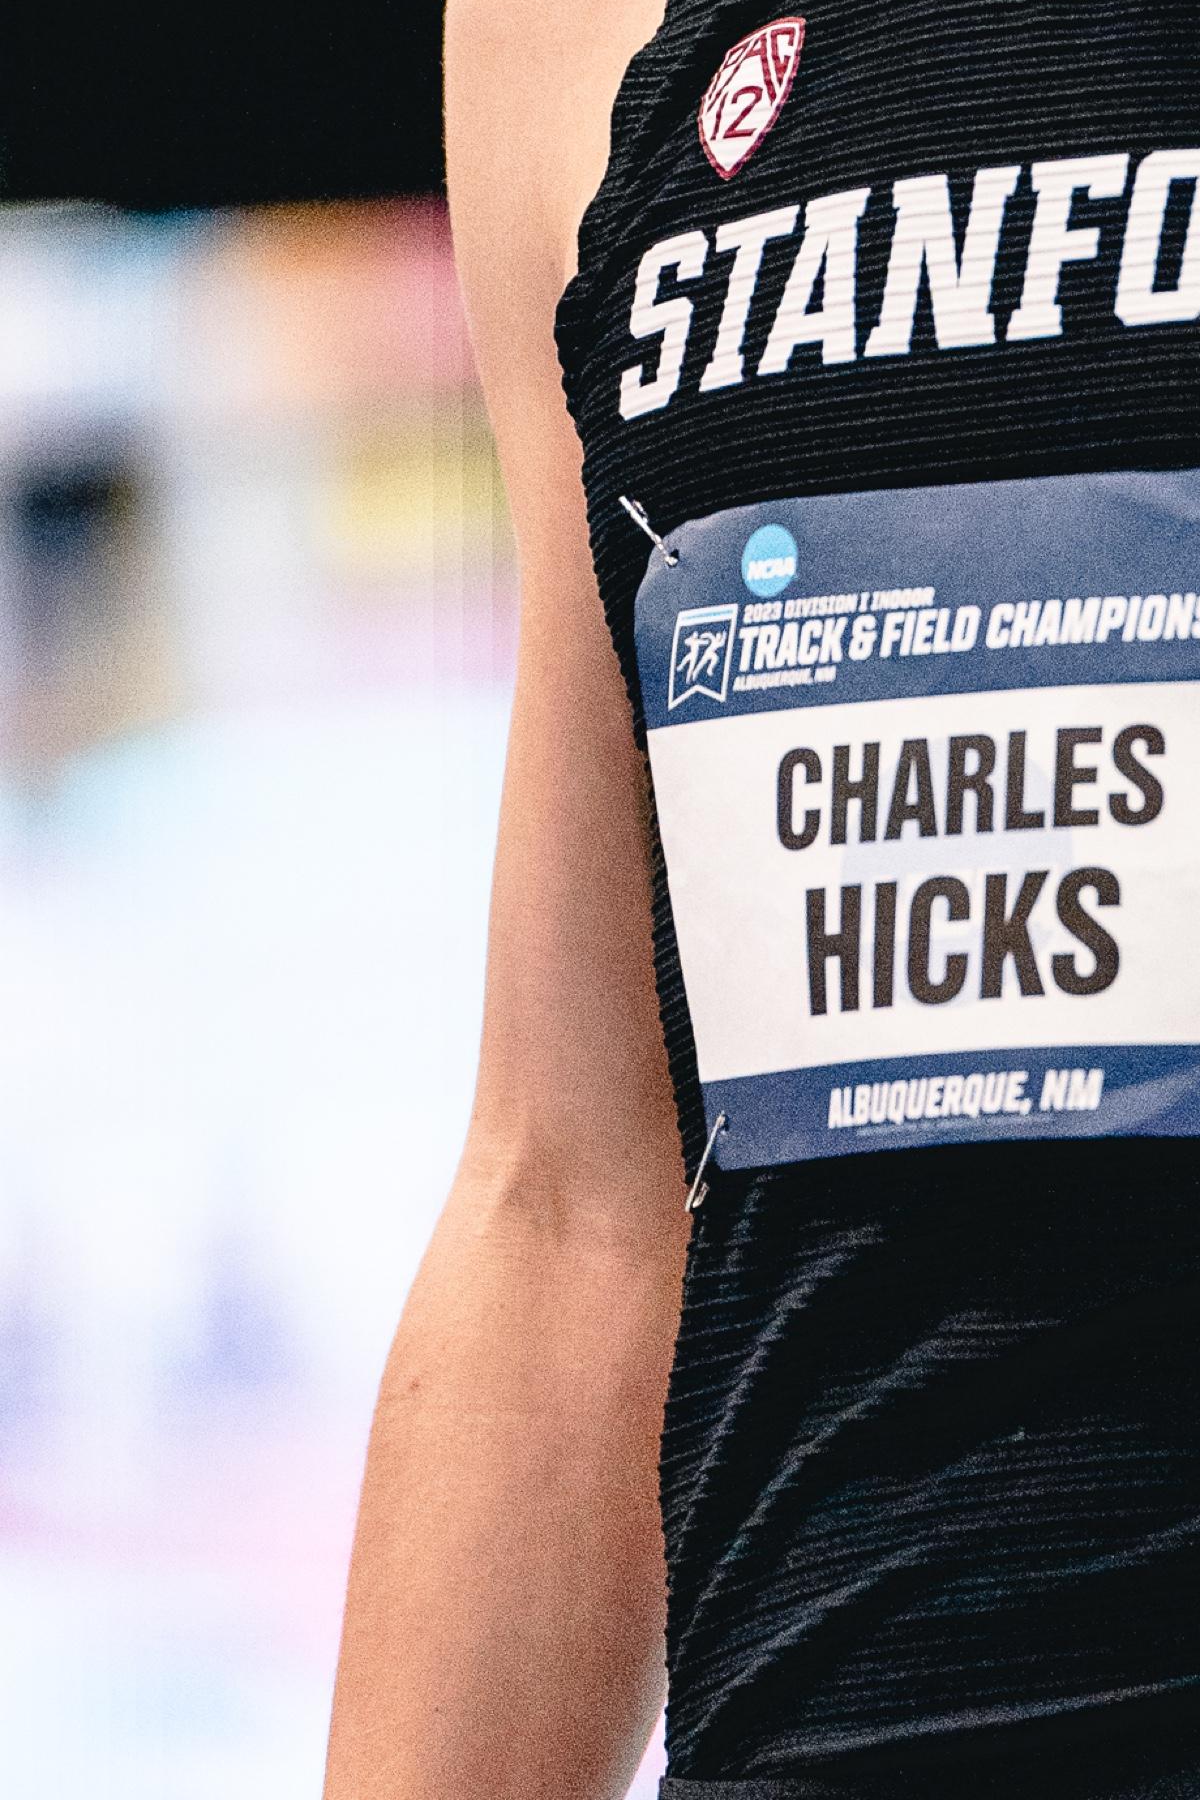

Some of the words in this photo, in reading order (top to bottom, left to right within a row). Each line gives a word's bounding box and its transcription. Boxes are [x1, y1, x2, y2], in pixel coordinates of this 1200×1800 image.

[709, 85, 763, 141] 12
[746, 556, 797, 582] NCAA
[783, 594, 858, 619] DIVISION
[869, 586, 936, 611] INDOOR
[738, 616, 848, 673] TRACK
[848, 613, 877, 661] &
[878, 605, 981, 658] FIELD
[776, 723, 1166, 851] CHARLES
[804, 866, 1122, 1016] HICKS
[828, 1070, 1033, 1129] ALBUQUERQUE,
[1038, 1067, 1105, 1111] NM
